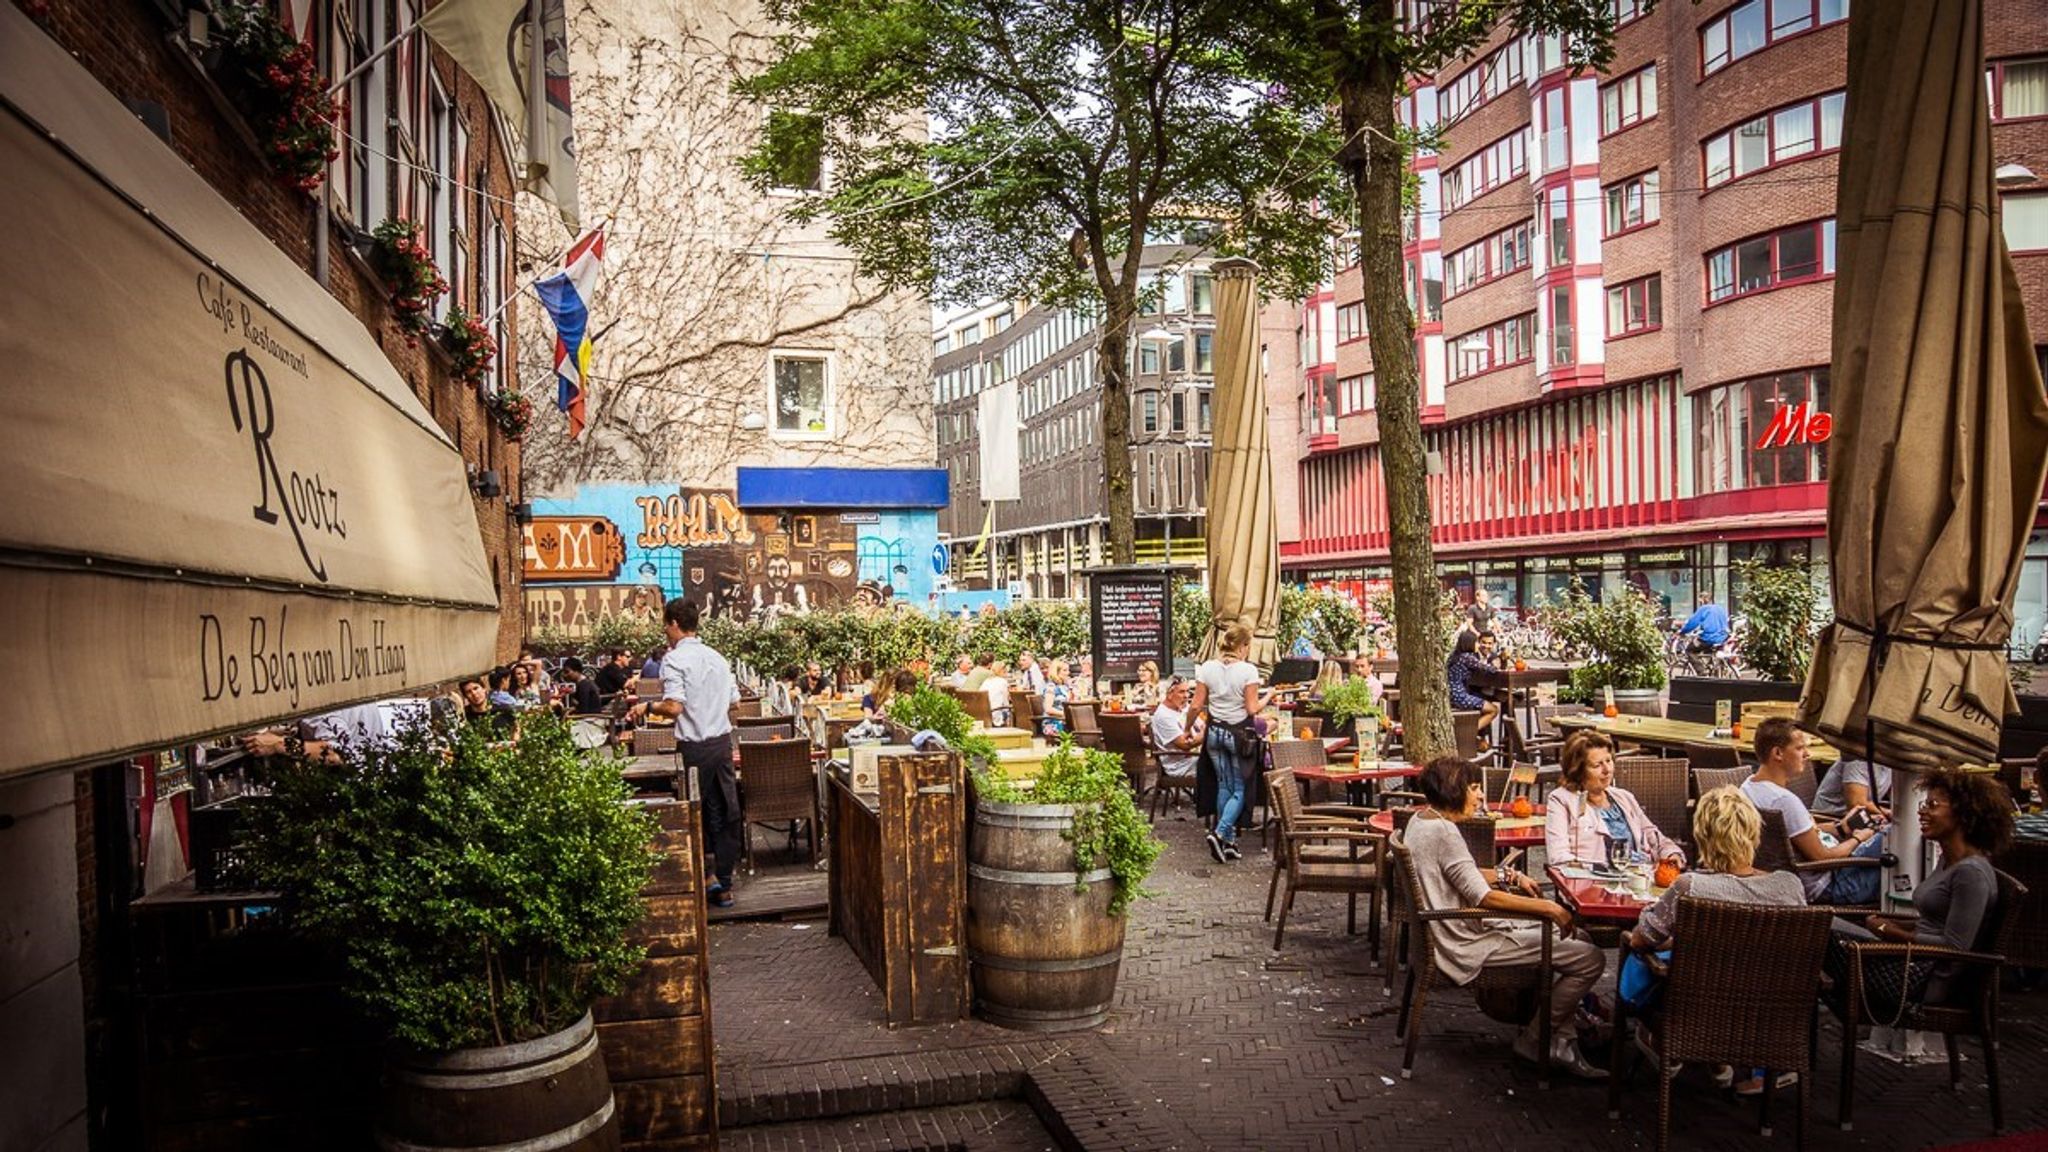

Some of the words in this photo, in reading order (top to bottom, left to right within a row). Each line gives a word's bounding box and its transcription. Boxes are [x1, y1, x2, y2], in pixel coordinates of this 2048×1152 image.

[197, 271, 236, 334] Café
[239, 301, 309, 379] Restaurant
[225, 347, 346, 583] Rootz
[200, 614, 241, 701] De
[250, 604, 299, 709] Belg
[302, 649, 335, 687] van
[338, 619, 370, 682] Den
[372, 619, 408, 686] Haag
